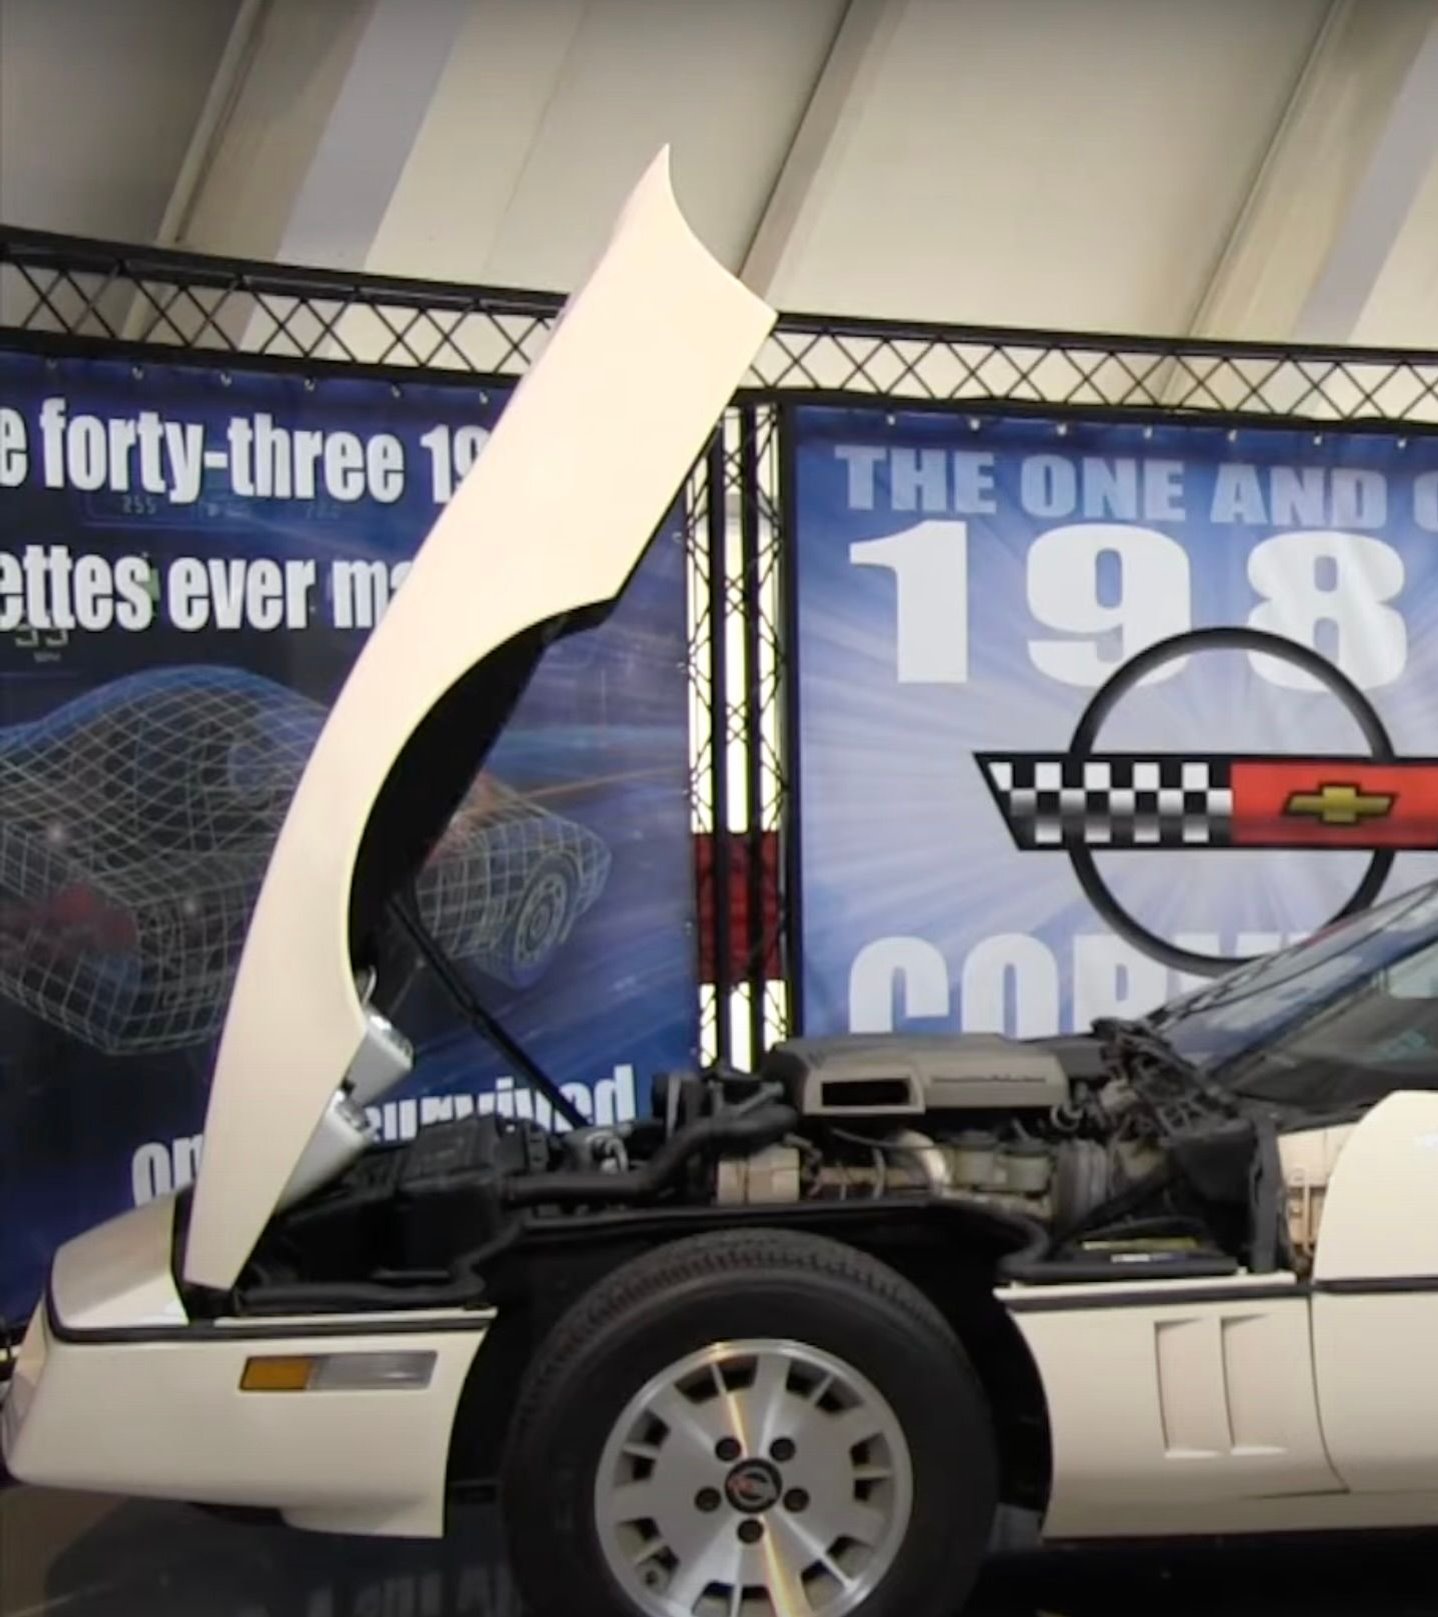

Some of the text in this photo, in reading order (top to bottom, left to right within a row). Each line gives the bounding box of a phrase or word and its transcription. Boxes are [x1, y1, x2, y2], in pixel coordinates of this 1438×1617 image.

[40, 397, 405, 503] forty-three
[835, 445, 998, 515] THE
[1021, 454, 1187, 522] ONE
[1210, 463, 1388, 530] AND
[168, 557, 317, 632] ever
[332, 560, 412, 629] m
